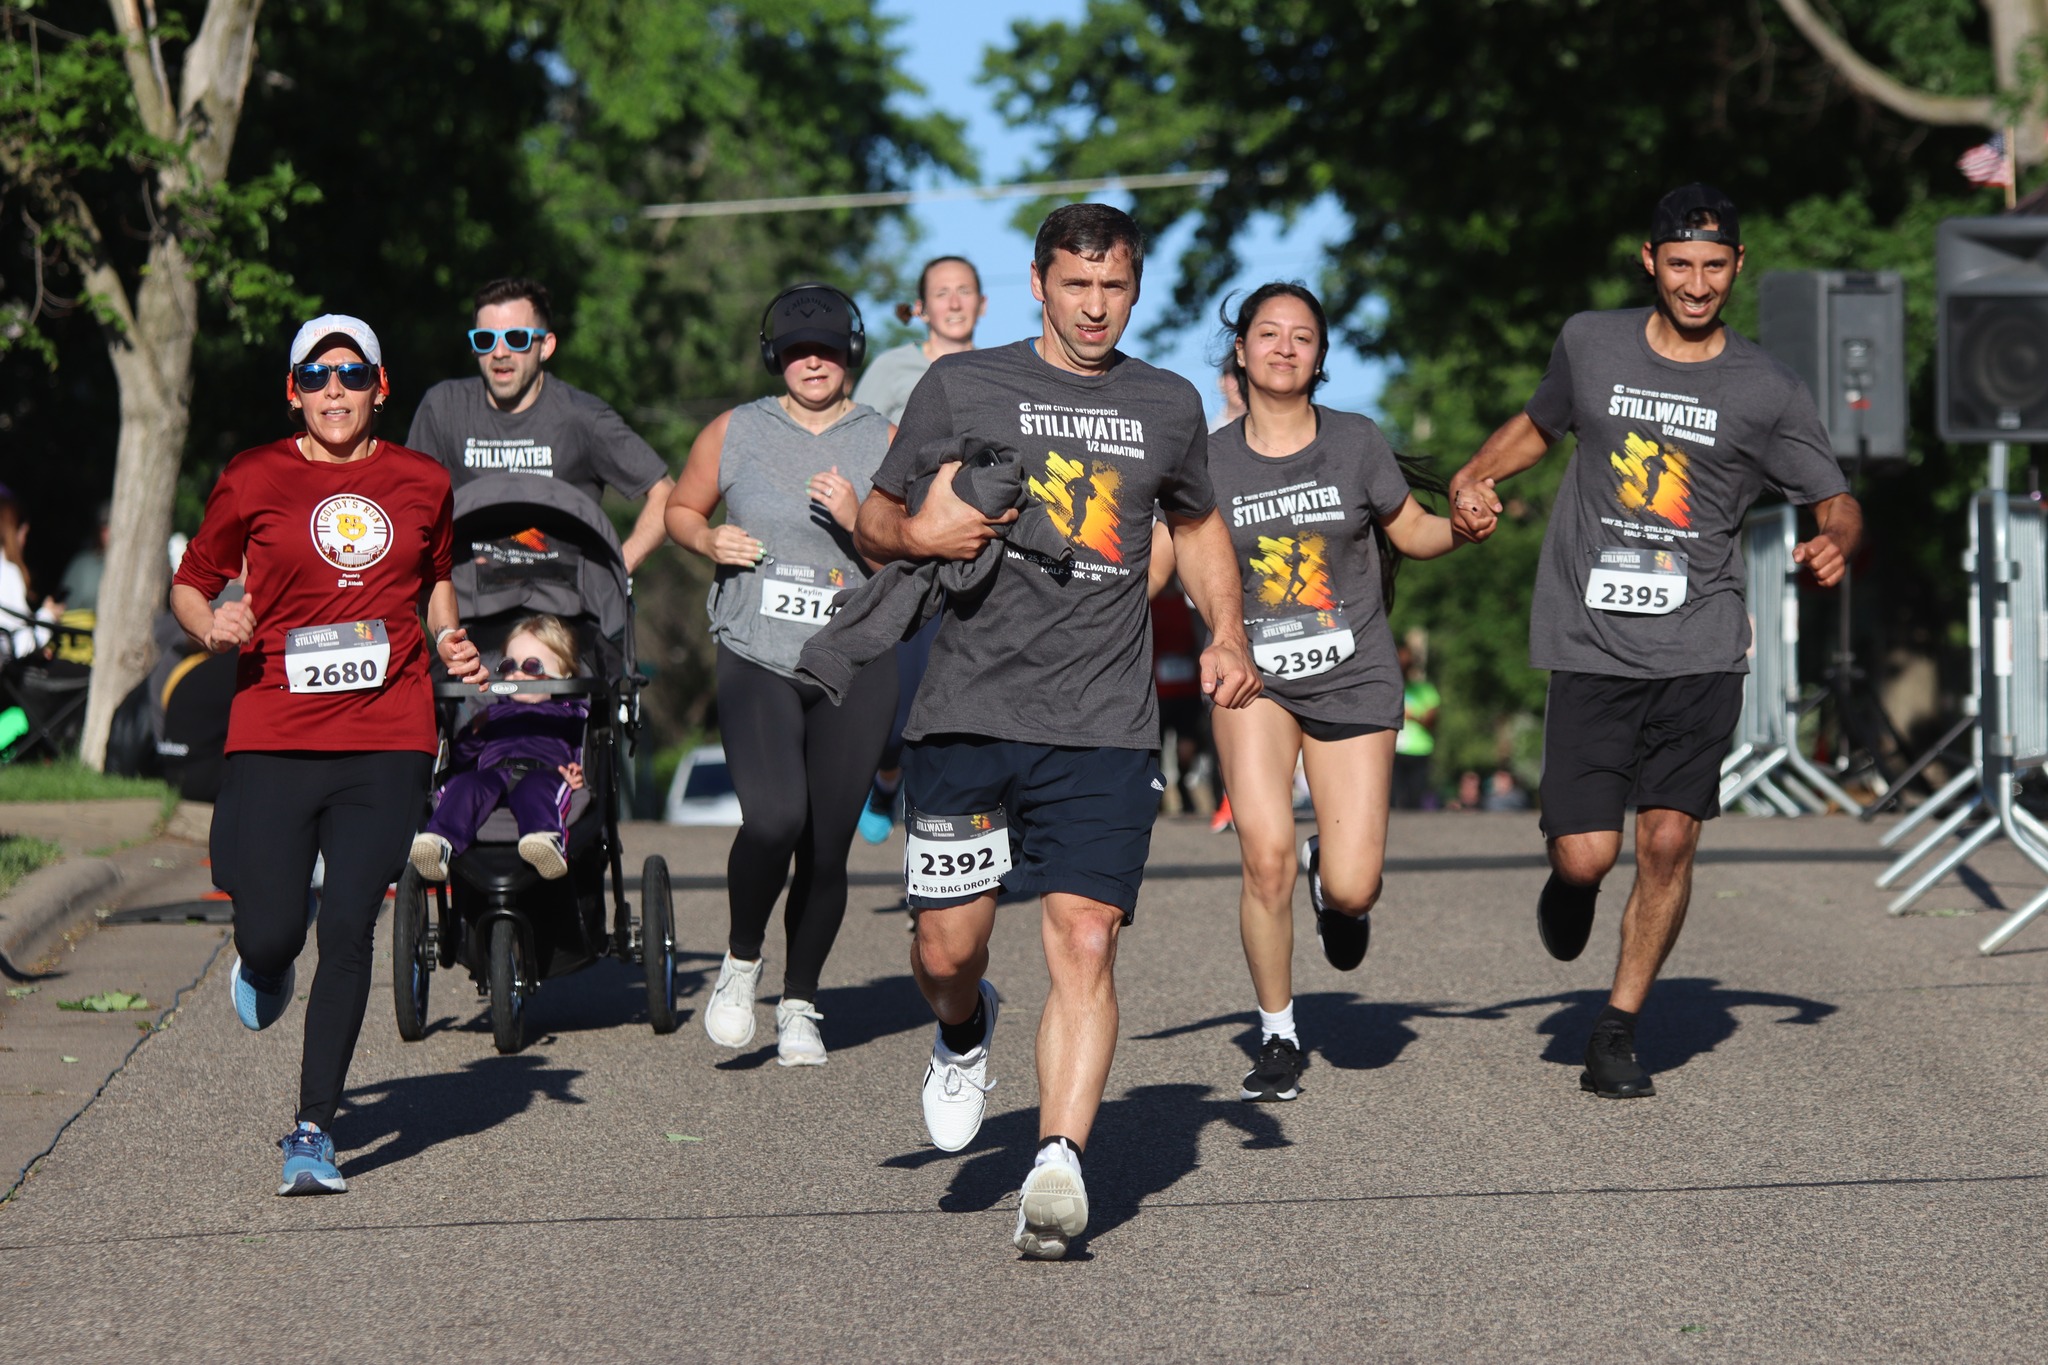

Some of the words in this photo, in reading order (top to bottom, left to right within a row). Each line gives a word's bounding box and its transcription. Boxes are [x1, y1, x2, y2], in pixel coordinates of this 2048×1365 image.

[1075, 408, 1118, 416] ORTHOPEDICS
[1608, 395, 1718, 431] STILLWATER
[1020, 413, 1144, 443] STILLWATER
[1662, 424, 1675, 436] 1/2
[1674, 428, 1716, 447] MARATHON
[464, 446, 552, 468] STILLWATER
[1086, 440, 1100, 453] 1/2
[1101, 443, 1145, 460] MARATHON
[1259, 490, 1277, 499] CITIES
[320, 500, 359, 522] GOLDY'S
[363, 505, 383, 523] RUN
[1233, 485, 1341, 528] STILLWATER
[1291, 513, 1304, 526] 1/2
[1305, 511, 1345, 523] MARATHON
[1069, 560, 1118, 576] STILLWATER,
[1600, 554, 1640, 564] STILLWATER
[776, 567, 815, 578] STILLWATER
[797, 587, 822, 597] Kaylin
[1601, 583, 1668, 608] 2395
[295, 630, 339, 647] STILLWATER
[1262, 621, 1303, 638] STILLWATER
[1273, 645, 1341, 675] 2394
[305, 659, 377, 687] 2680
[920, 847, 995, 876] 2392
[922, 885, 938, 893] 2392
[940, 885, 962, 893] BAG
[963, 878, 990, 891] DROP
